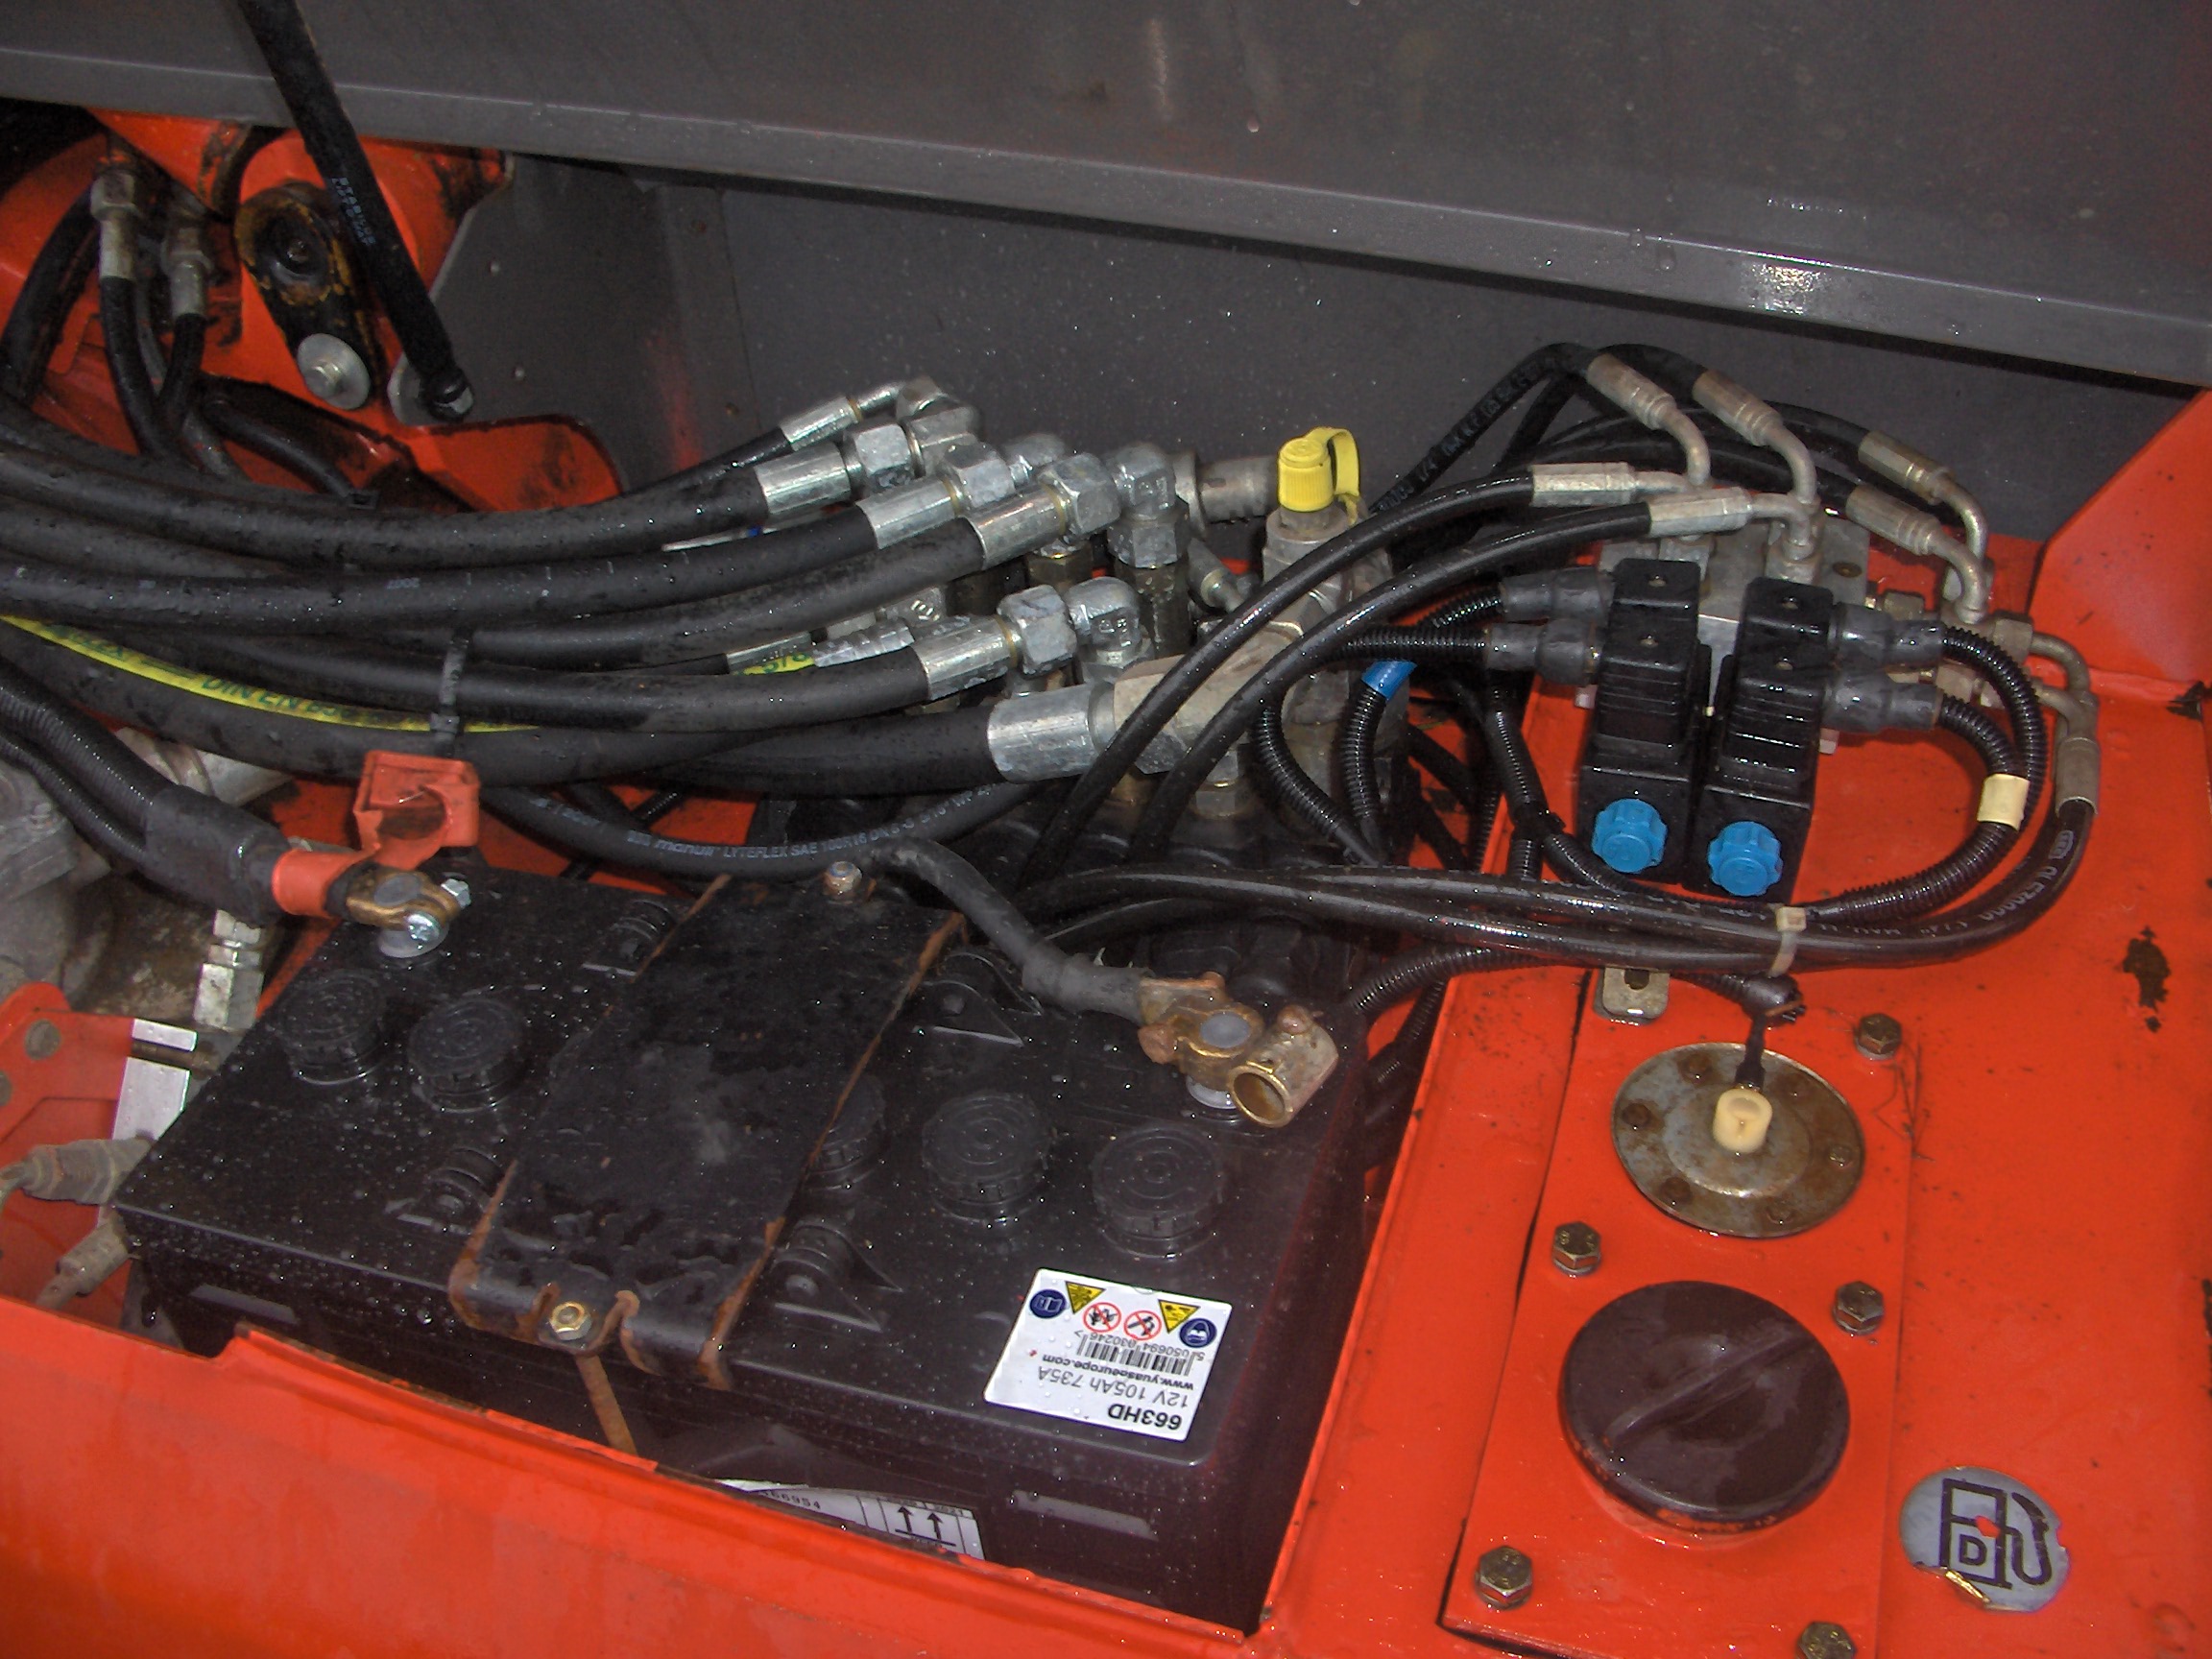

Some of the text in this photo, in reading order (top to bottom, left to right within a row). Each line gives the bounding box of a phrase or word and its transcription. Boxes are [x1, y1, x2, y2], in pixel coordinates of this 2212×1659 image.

[790, 843, 818, 856] SAE
[1142, 1342, 1191, 1358] 050694
[1197, 1351, 1206, 1361] 5
[1038, 1365, 1189, 1408] 12V 105Ah 735A
[1107, 1403, 1183, 1431] 663HD
[1959, 1534, 1987, 1566] D
